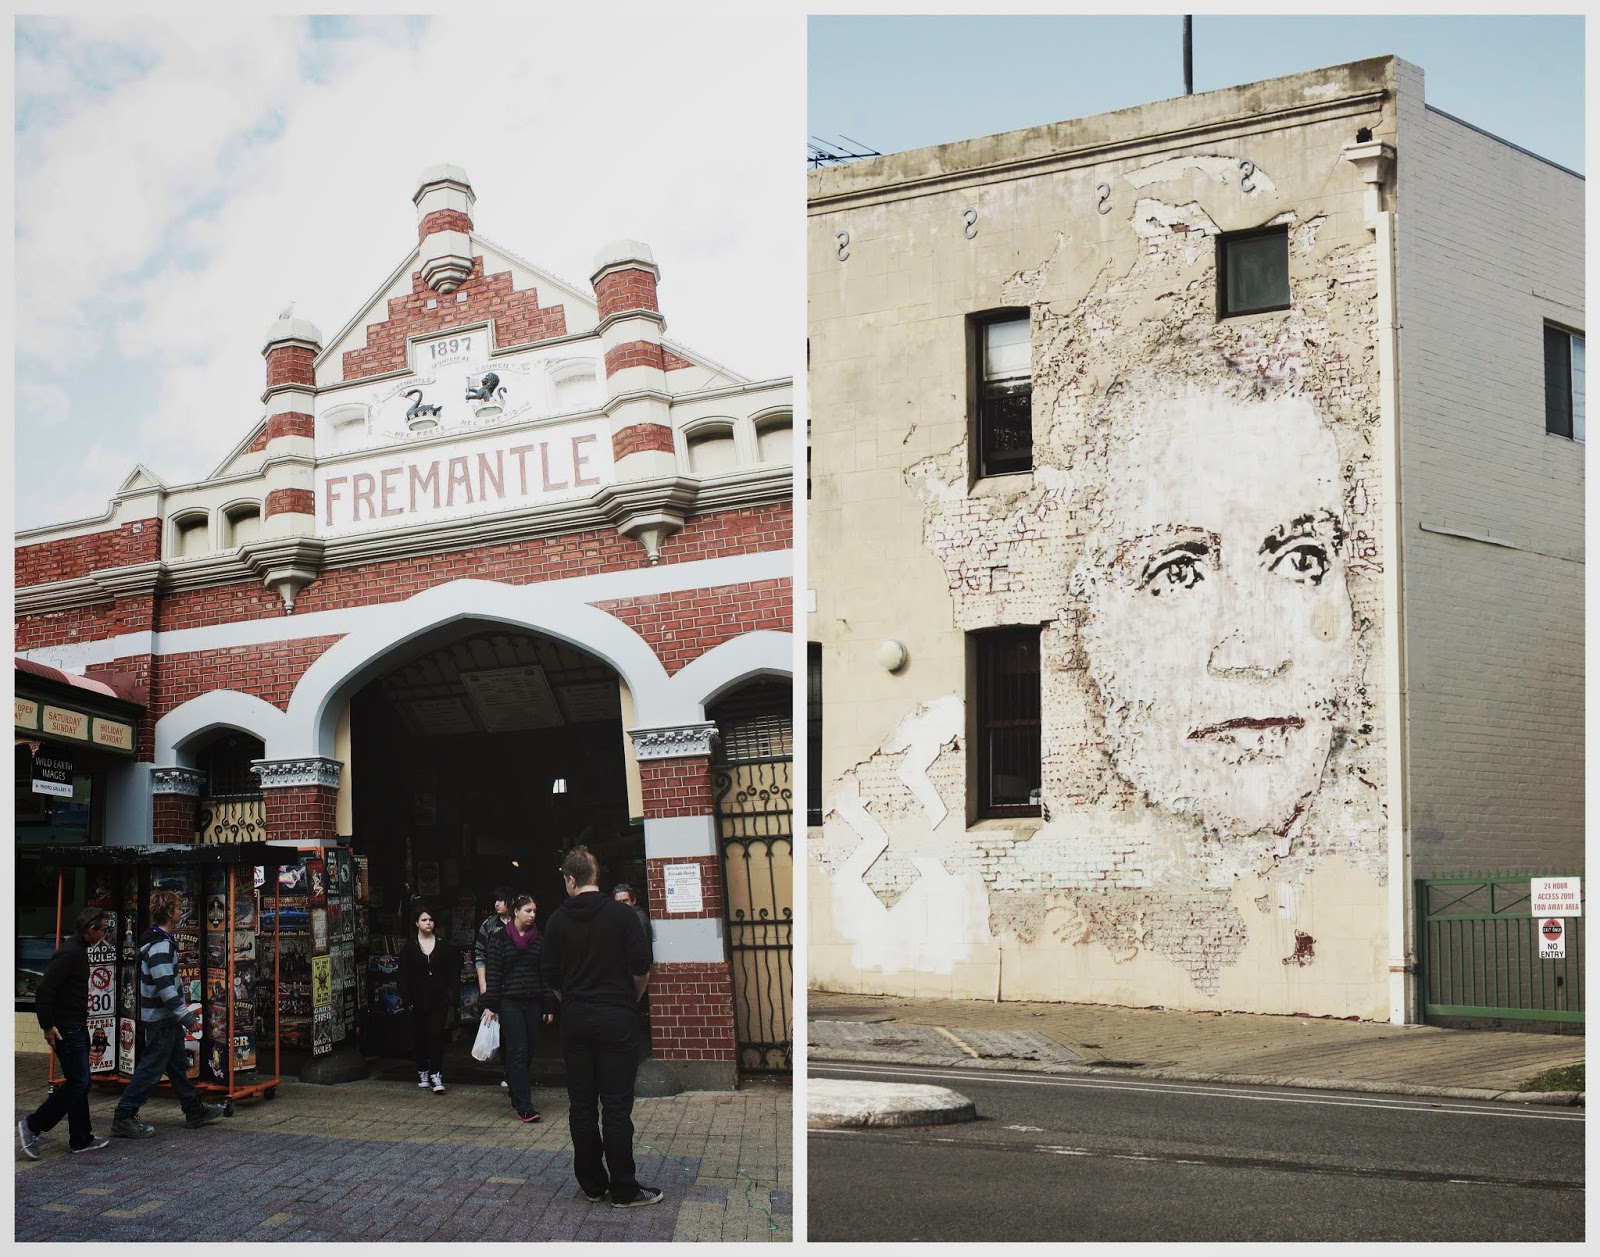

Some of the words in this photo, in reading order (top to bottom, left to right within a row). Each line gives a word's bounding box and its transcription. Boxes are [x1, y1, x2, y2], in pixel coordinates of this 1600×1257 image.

[428, 336, 472, 360] 1897
[431, 356, 470, 370] MUNICIPAL
[475, 363, 509, 372] COUNCIL
[391, 376, 431, 393] FREMANTLE
[325, 433, 601, 527] FREMANTLE
[17, 705, 34, 715] OPEN
[48, 711, 82, 727] SATURDAY
[52, 722, 78, 735] SUNDAY
[100, 723, 125, 736] HOLIDAY
[100, 733, 124, 745] MONDAY
[35, 756, 53, 768] WILD
[53, 759, 73, 771] EARTH
[42, 768, 66, 781] IMAGES
[40, 783, 52, 791] PHOTO
[87, 945, 117, 954] DAD'S
[87, 952, 118, 963] RULES
[313, 1043, 333, 1055] RULES
